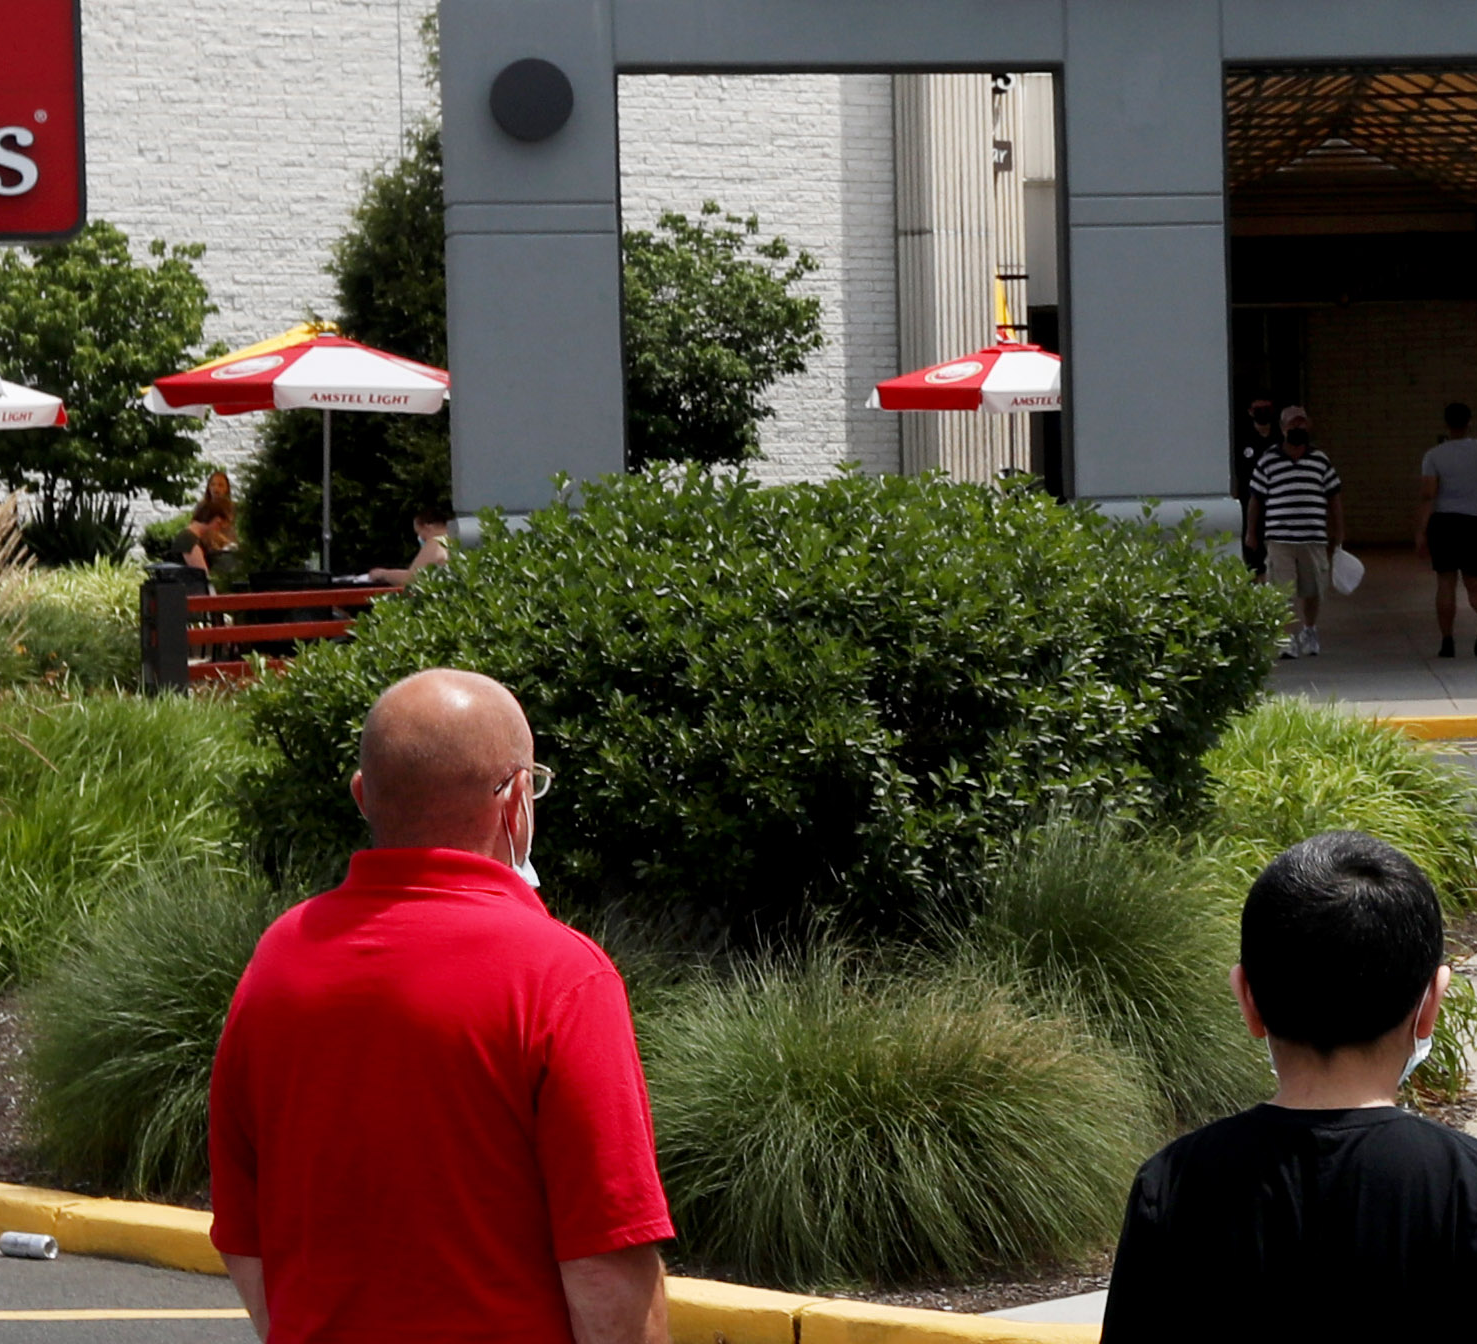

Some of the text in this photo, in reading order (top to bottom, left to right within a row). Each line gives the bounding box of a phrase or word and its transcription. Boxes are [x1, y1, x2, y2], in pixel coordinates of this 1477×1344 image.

[309, 392, 411, 405] AMSTEL LIGHT
[1010, 397, 1054, 407] AMSTEL
[2, 411, 34, 422] LIGHT
